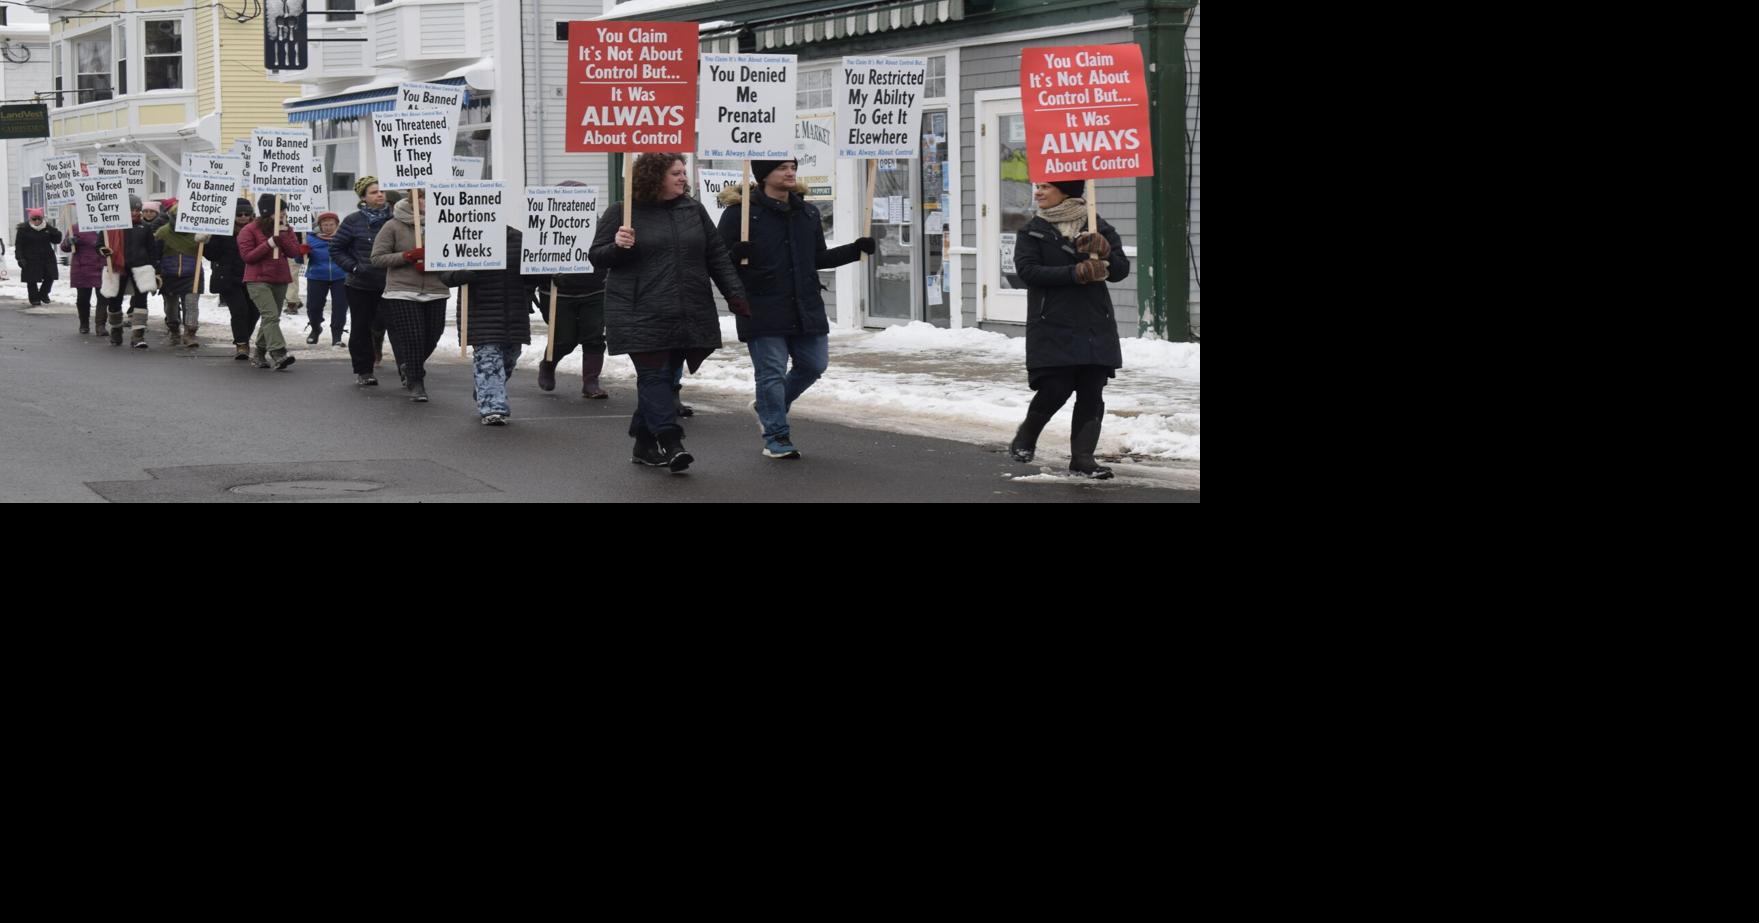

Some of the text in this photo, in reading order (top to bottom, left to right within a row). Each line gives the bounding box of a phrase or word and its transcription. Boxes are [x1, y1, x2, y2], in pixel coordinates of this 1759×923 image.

[596, 28, 667, 43] You Claim
[579, 46, 682, 61] It's Not About
[1044, 52, 1114, 68] You Claim
[586, 64, 680, 79] Control But...
[710, 65, 786, 83] You Denied
[845, 69, 924, 85] You Restricted
[1030, 70, 1130, 88] It's Not About
[404, 90, 457, 105] You Banned
[612, 87, 655, 101] It Was
[737, 86, 757, 102] Me
[849, 89, 915, 108] My Ability
[1038, 88, 1131, 105] Control But...
[581, 106, 685, 126] ALWAYS
[719, 107, 775, 123] Prenatal
[854, 109, 907, 124] To Get It
[1066, 112, 1110, 127] It Was
[375, 117, 446, 132] You Threatened
[583, 130, 681, 144] About Control
[731, 127, 761, 143] Care
[802, 121, 830, 145] MARKET
[849, 128, 907, 144] Elsewhere
[257, 137, 308, 148] You Banned
[382, 133, 441, 149] My Friends
[1041, 128, 1140, 154] ALWAYS
[263, 150, 300, 160] Methods
[394, 149, 431, 162] If They
[47, 163, 57, 171] You
[60, 161, 71, 169] Said
[210, 160, 224, 169] You
[259, 162, 268, 172] To
[272, 163, 304, 173] Prevent
[397, 163, 432, 178] Helped
[880, 159, 894, 168] OPEN
[1045, 154, 1139, 173] About Control
[45, 173, 56, 181] Can
[58, 170, 70, 179] Only
[129, 168, 144, 176] Carry
[452, 166, 464, 176] You
[46, 182, 63, 190] Helped
[80, 181, 121, 191] You Forced
[187, 179, 234, 192] You Banned
[253, 174, 308, 186] Implantation
[704, 180, 720, 192] You
[47, 191, 60, 200] Brink
[312, 184, 322, 194] Of
[86, 192, 117, 201] Children
[190, 191, 227, 205] Aborting
[433, 191, 501, 206] You Banned
[86, 203, 119, 212] To Carry
[192, 202, 221, 214] Ectopic
[528, 198, 595, 211] You Threatened
[101, 213, 119, 222] Term
[181, 215, 229, 226] Pregnancies
[288, 214, 308, 225] aped
[438, 210, 496, 223] Abortions
[529, 215, 589, 230] My Doctors
[453, 226, 483, 240] After
[540, 232, 576, 246] If They
[443, 244, 491, 257] 6 Weeks
[523, 248, 588, 262] Performed On
